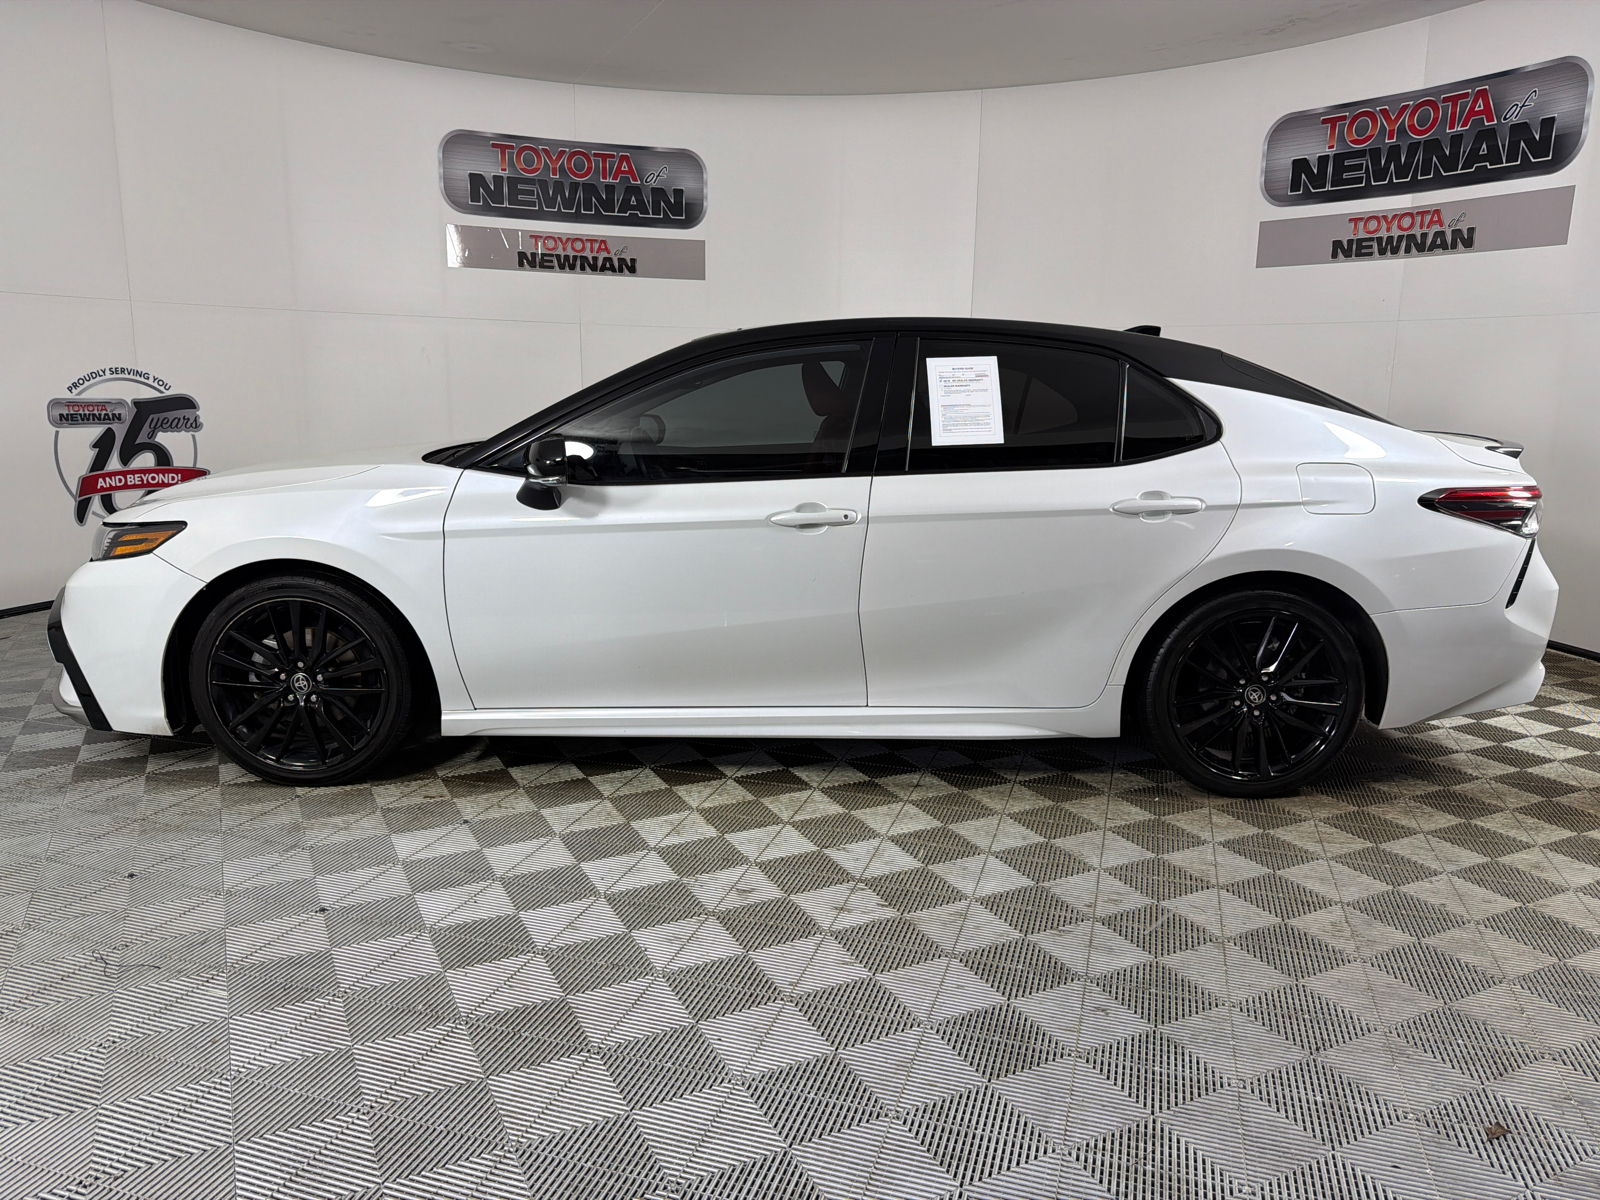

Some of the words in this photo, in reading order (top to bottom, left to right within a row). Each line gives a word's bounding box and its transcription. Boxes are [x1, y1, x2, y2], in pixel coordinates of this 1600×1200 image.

[1321, 86, 1496, 149] TOYOTA
[1501, 88, 1538, 123] of
[490, 141, 641, 183] TOYOTA
[643, 166, 668, 185] of
[1288, 114, 1557, 195] NEWNAN
[467, 172, 686, 219] NEWNAN
[1348, 208, 1444, 236] TOYOTA
[529, 234, 611, 255] TOYOTA
[1330, 227, 1476, 260] NEWNAN
[517, 251, 637, 274] NEWNAN
[66, 367, 107, 394] PROUDLY
[108, 366, 150, 381] SERVING
[152, 374, 172, 391] YOU
[58, 412, 122, 423] NEWNAN
[65, 404, 108, 413] TOYOTA
[147, 413, 201, 440] years
[97, 475, 125, 489] AND
[127, 473, 182, 486] BEYOND!
